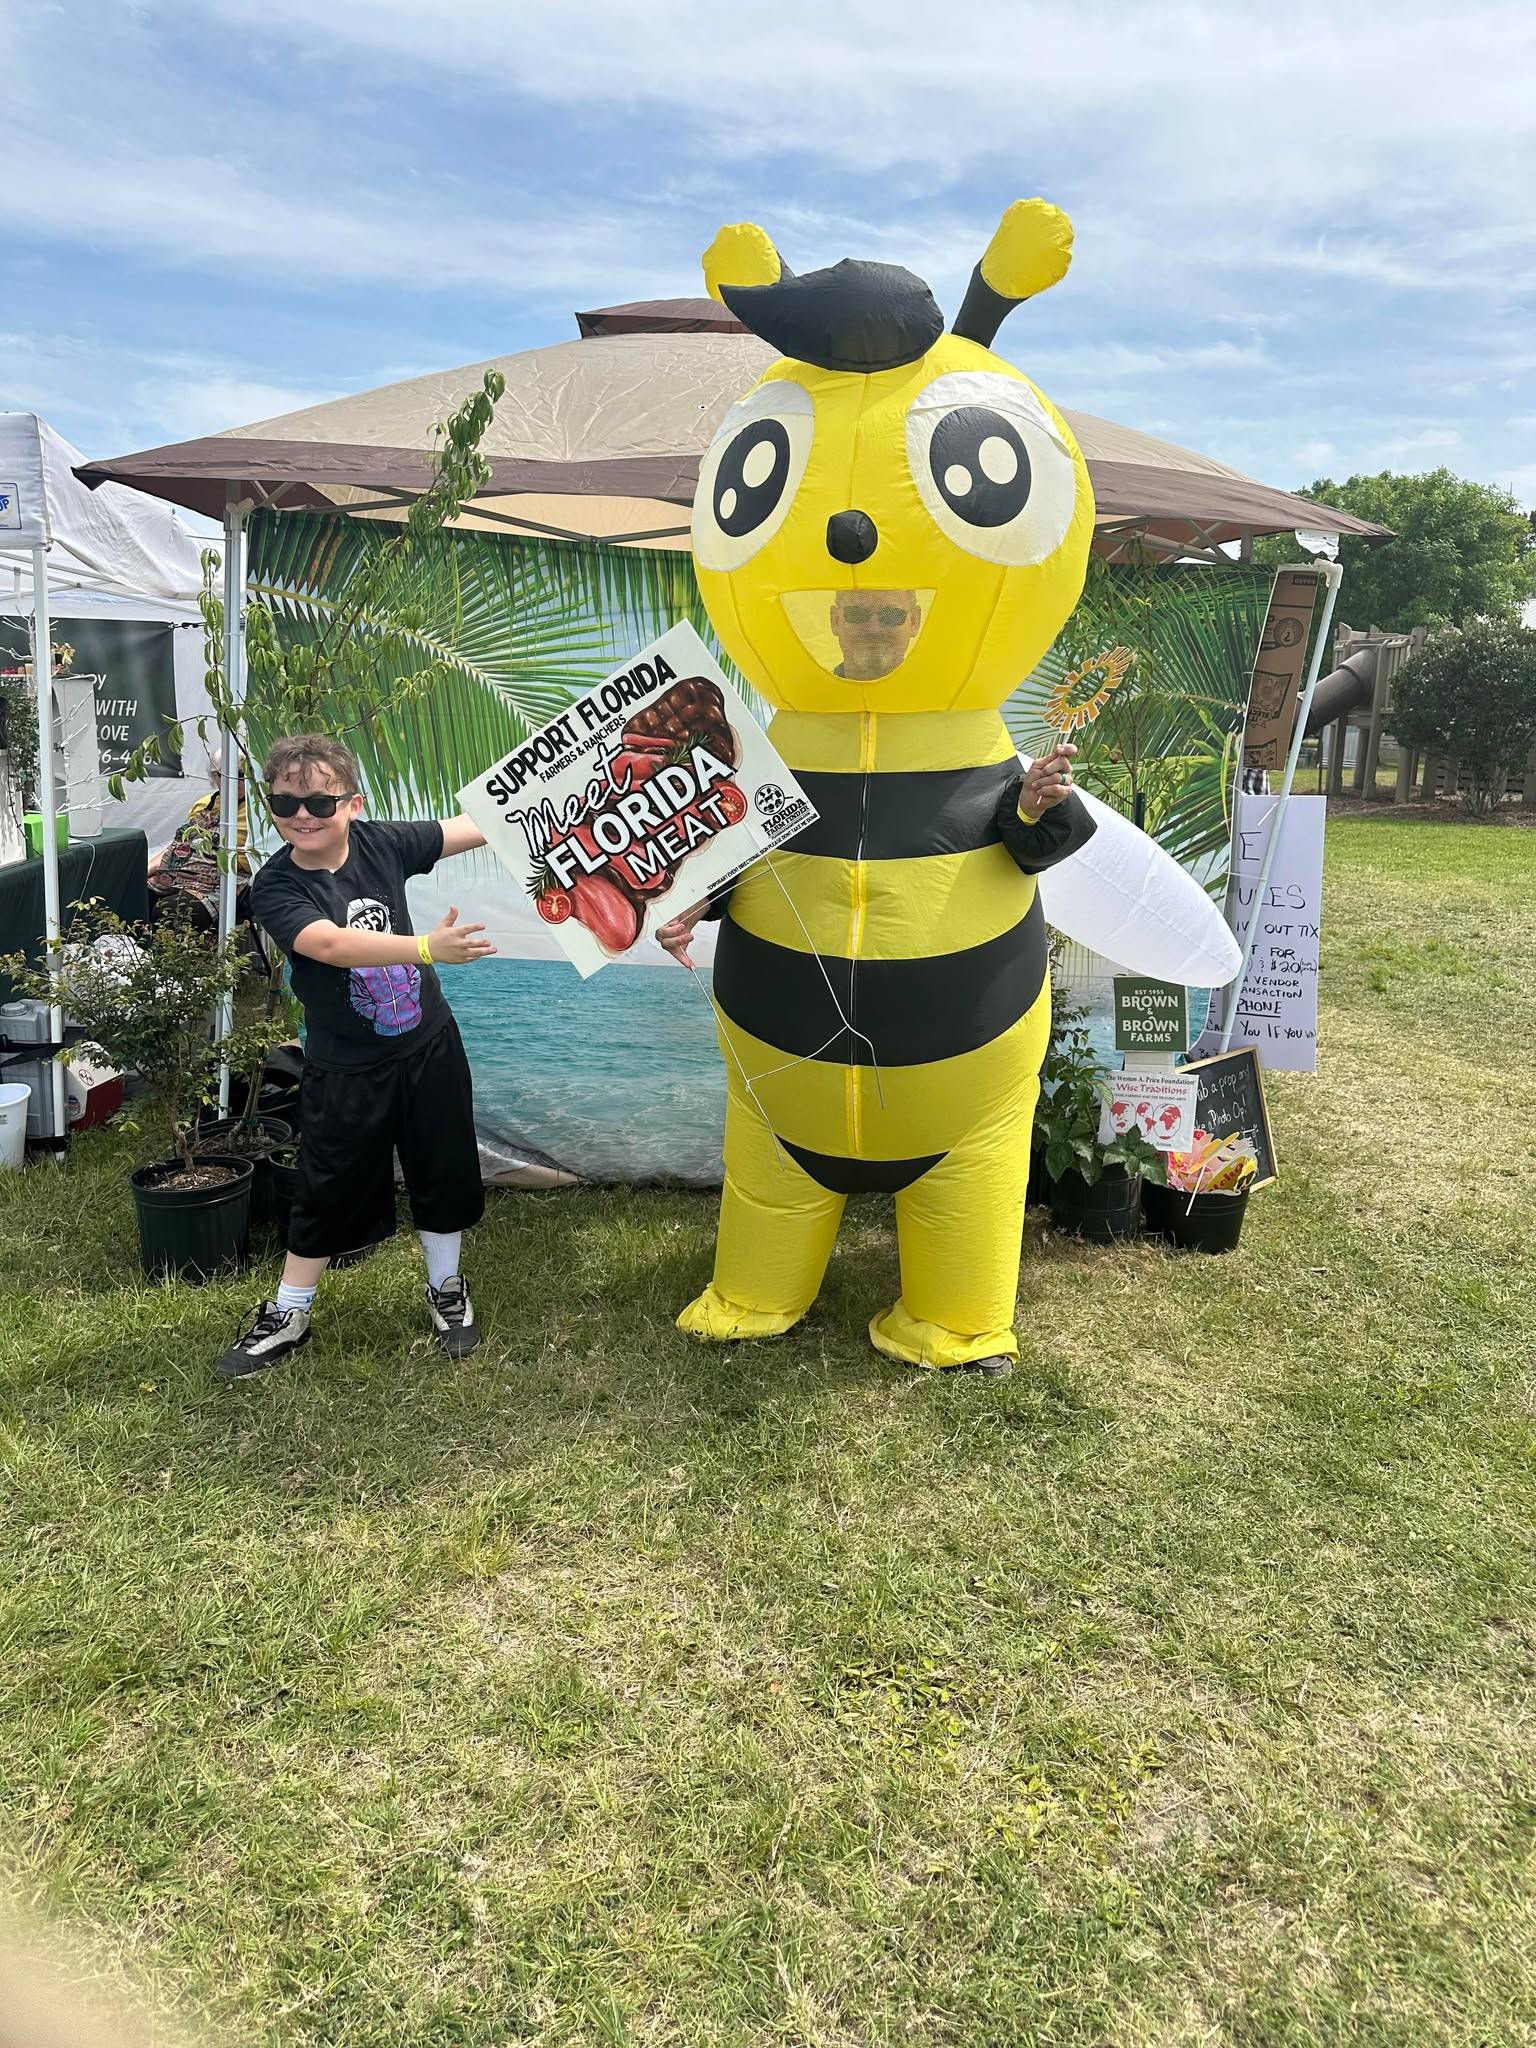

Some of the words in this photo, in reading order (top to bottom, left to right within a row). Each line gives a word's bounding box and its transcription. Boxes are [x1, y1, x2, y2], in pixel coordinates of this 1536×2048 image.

[96, 699, 138, 716] WITH
[486, 714, 579, 805] SUPPORT
[576, 654, 678, 731] FLORIDA
[539, 750, 578, 783] FARMERS
[575, 745, 586, 757] &
[583, 714, 627, 751] RANCHERS
[506, 742, 633, 858] Meet
[545, 745, 737, 890] FLORIDA
[761, 798, 806, 832] FLORIDA
[766, 822, 785, 837] FARM
[782, 806, 810, 824] FINDER
[625, 792, 729, 884] MEAT
[1264, 923, 1294, 936] OUT
[1298, 923, 1319, 938] TIX
[1270, 947, 1296, 961] FOR
[1254, 976, 1299, 987] VENDOR
[1241, 986, 1302, 998] ANSACTION
[1122, 995, 1179, 1011] BROWN
[1147, 1007, 1154, 1015] &
[1236, 998, 1282, 1014] PHONE
[1122, 1016, 1179, 1032] BROWN
[1267, 1023, 1281, 1039] IF
[1130, 1033, 1172, 1042] FARMS
[1116, 1083, 1139, 1092] Wise
[1140, 1084, 1188, 1095] Traditions
[1161, 1077, 1195, 1085] Foundation
[1211, 1083, 1218, 1093] a
[1219, 1074, 1237, 1098] prop
